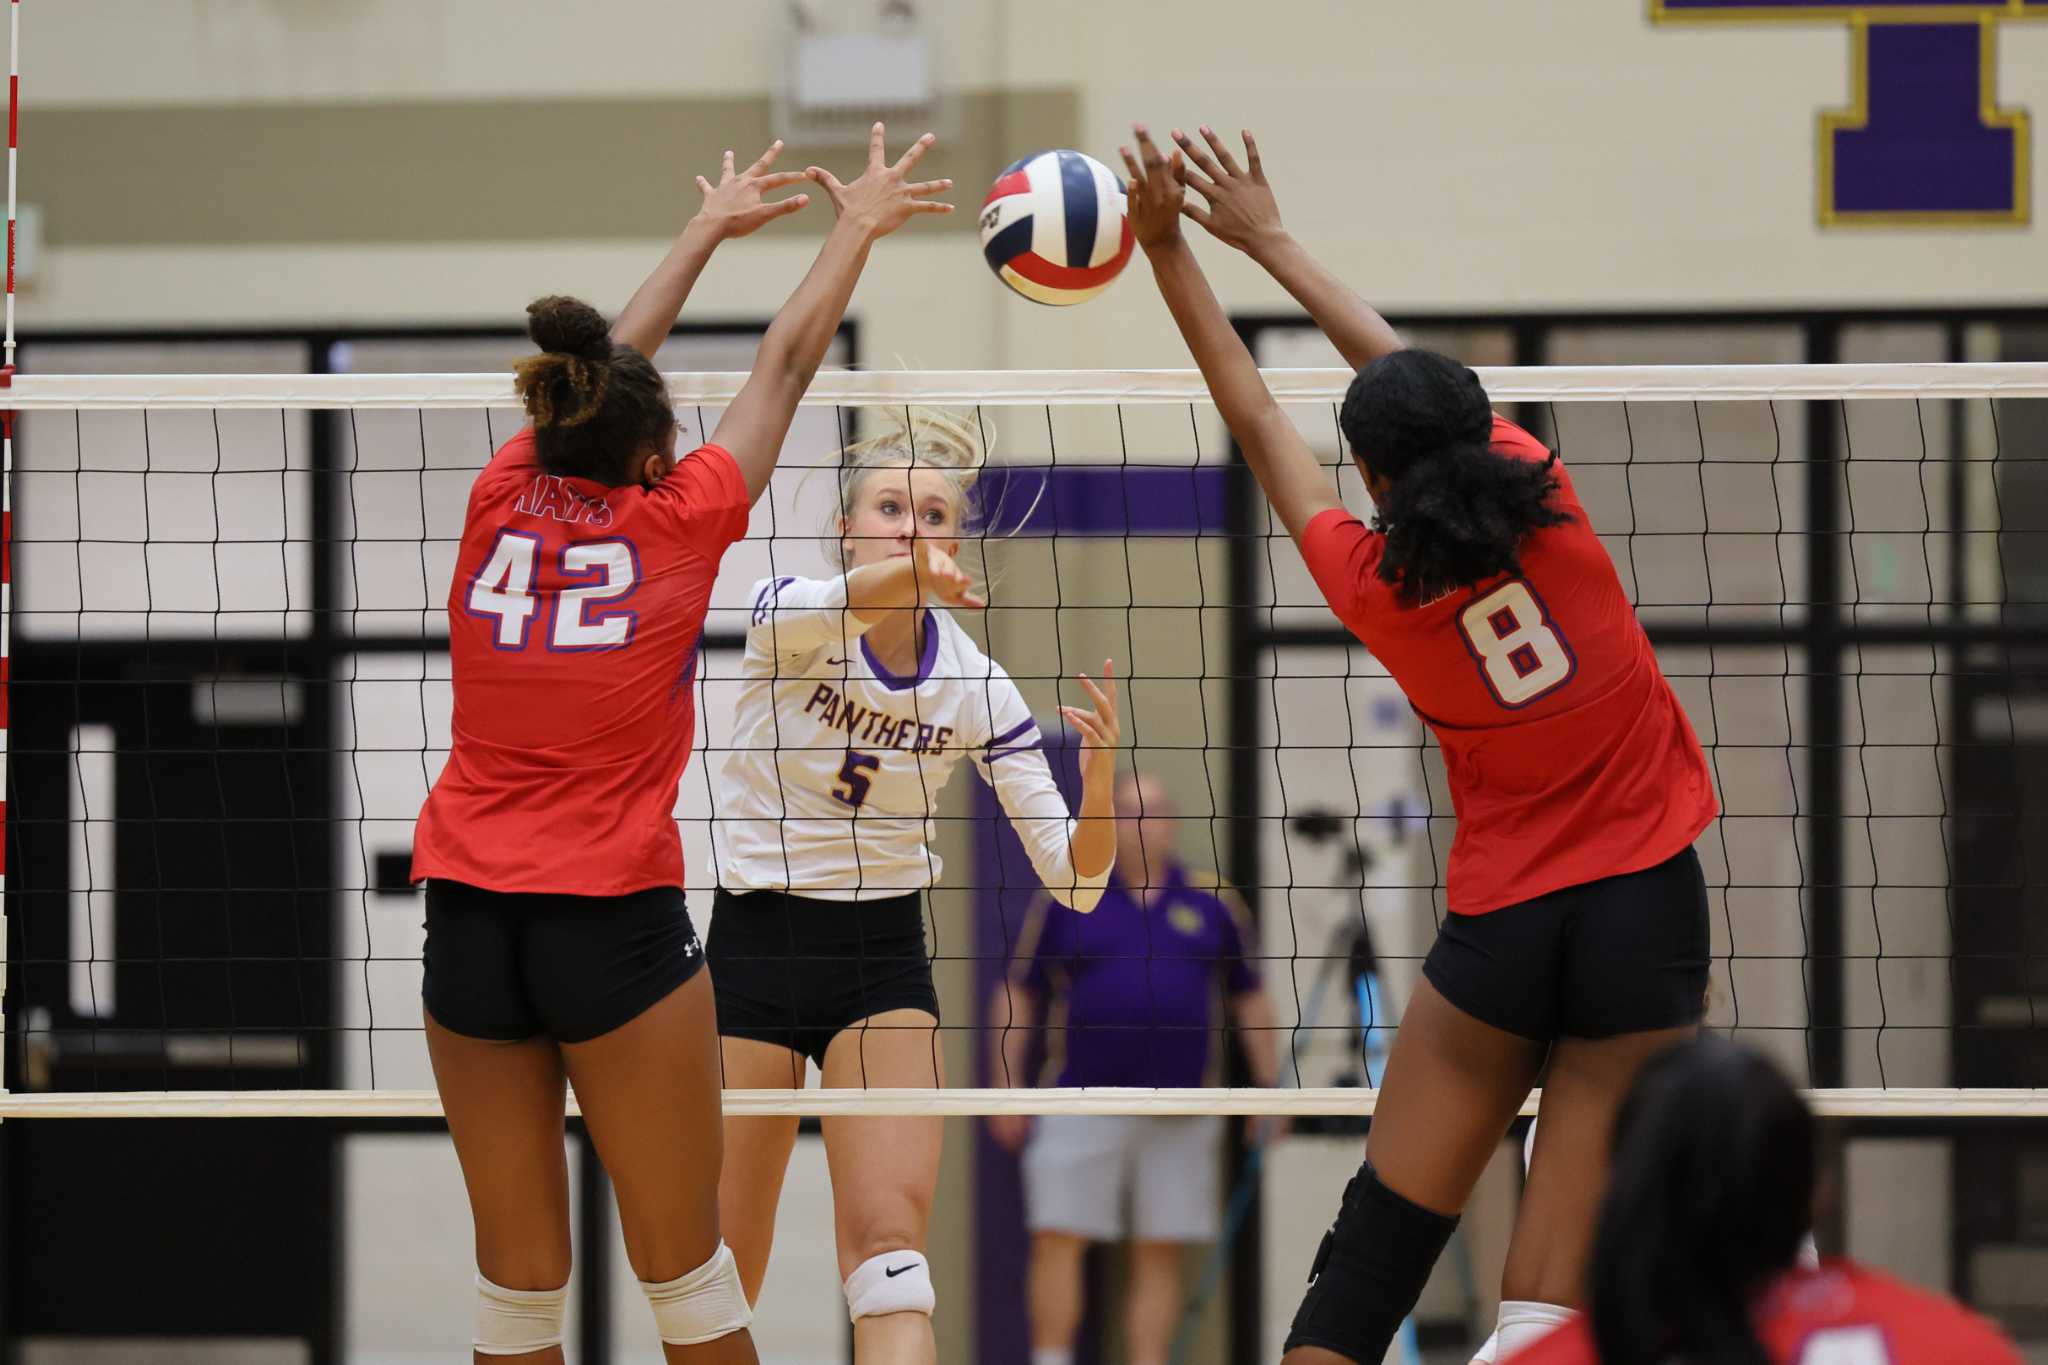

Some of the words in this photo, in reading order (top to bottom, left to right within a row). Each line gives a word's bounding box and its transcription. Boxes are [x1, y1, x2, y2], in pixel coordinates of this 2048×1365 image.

[466, 530, 641, 652] 42
[1457, 577, 1577, 708] 8
[804, 683, 953, 756] PANTHERS
[831, 750, 880, 808] 5
